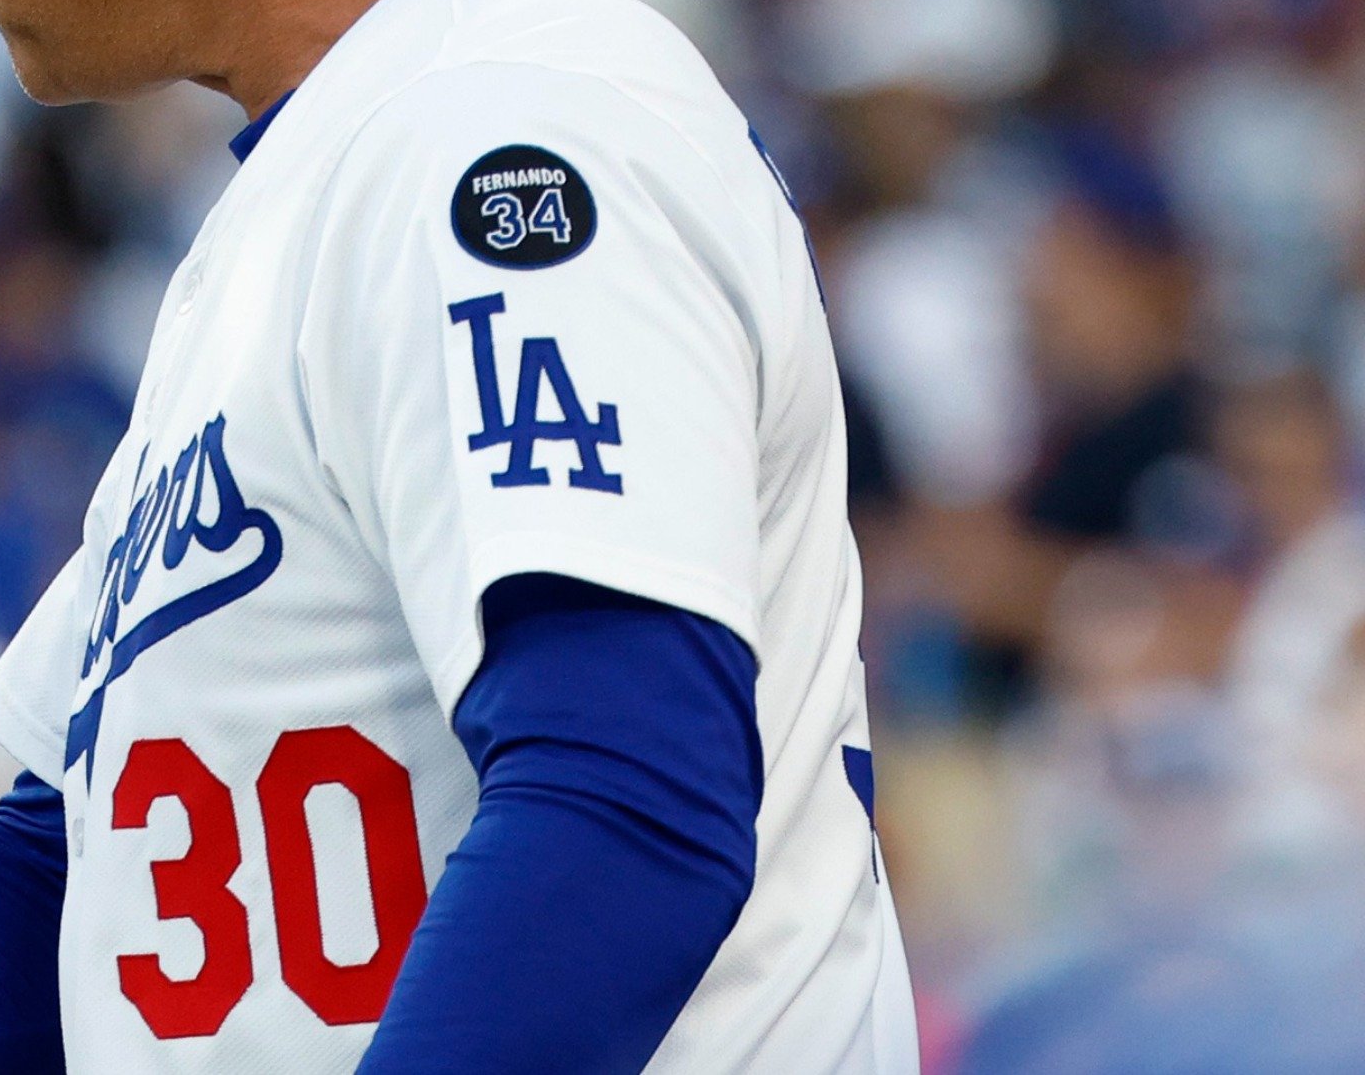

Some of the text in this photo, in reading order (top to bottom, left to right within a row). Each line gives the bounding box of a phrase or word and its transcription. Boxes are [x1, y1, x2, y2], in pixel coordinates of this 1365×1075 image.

[472, 168, 568, 195] FERNANDO
[481, 188, 572, 251] 34
[448, 292, 624, 496] LA
[111, 725, 429, 1040] 30
